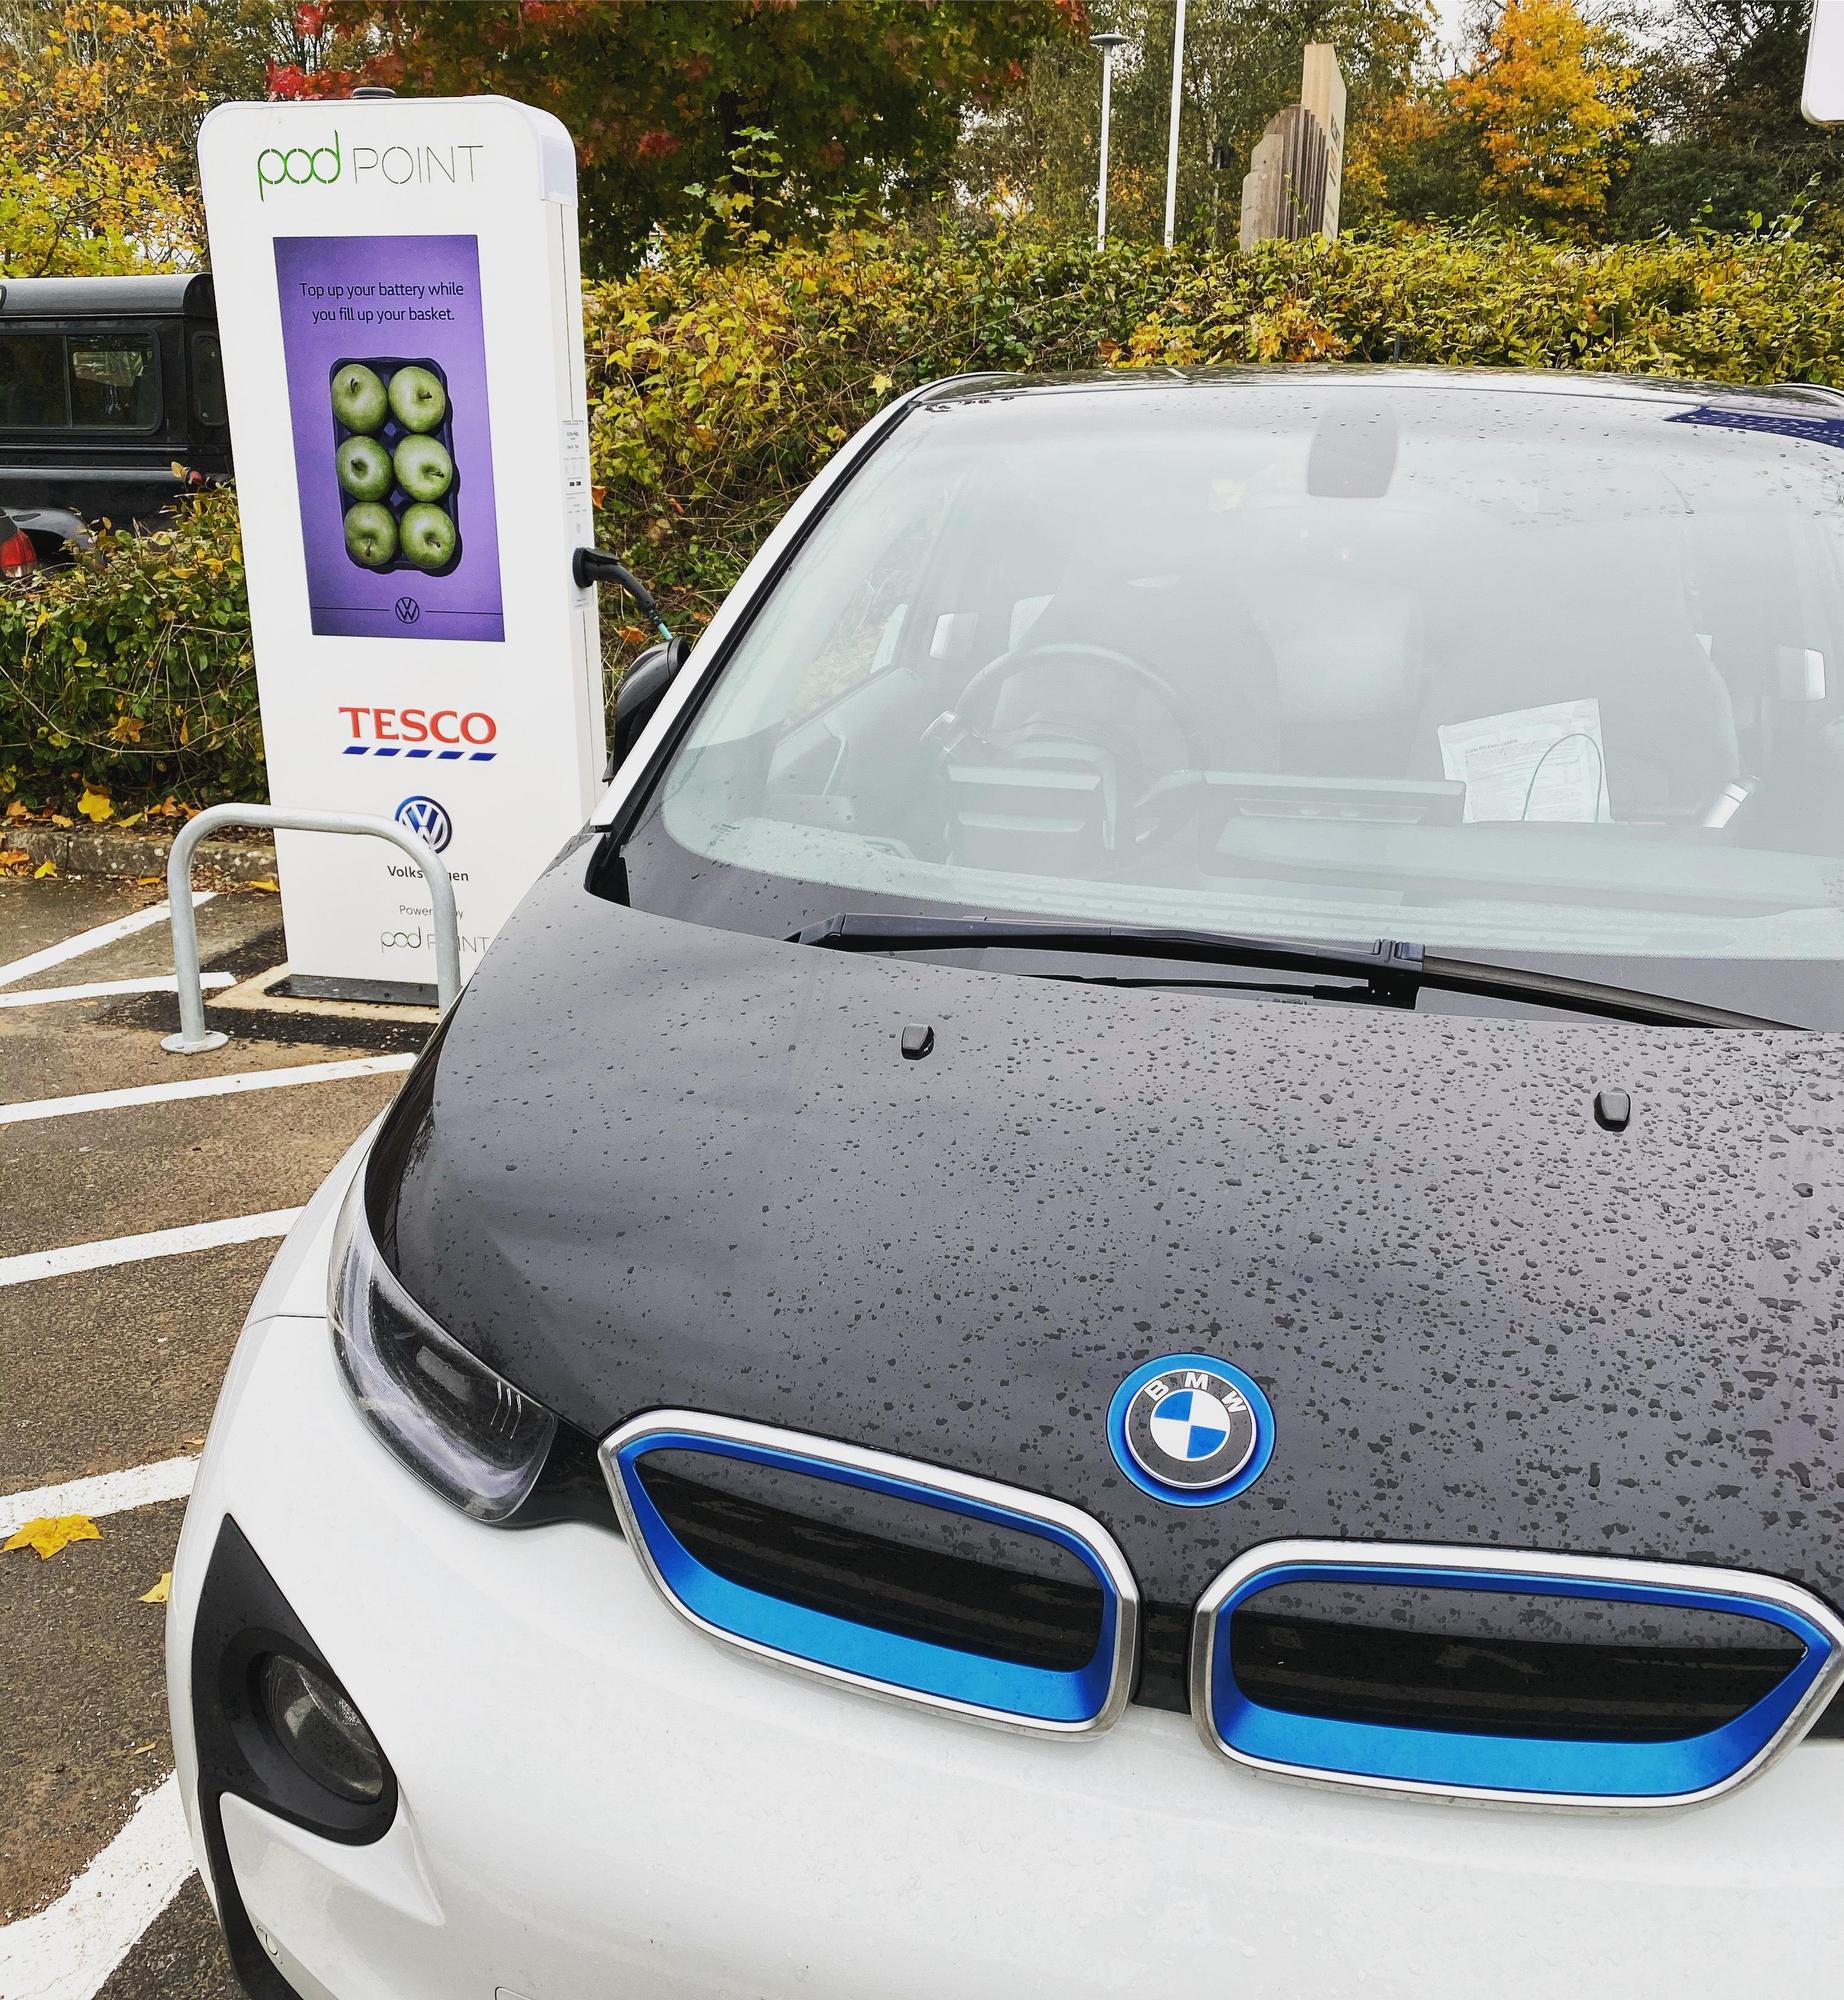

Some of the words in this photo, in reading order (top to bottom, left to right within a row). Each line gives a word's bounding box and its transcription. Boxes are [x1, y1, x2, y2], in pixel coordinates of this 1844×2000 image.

[257, 130, 341, 202] pod
[353, 145, 484, 185] POINT
[300, 283, 324, 299] Top
[328, 285, 344, 299] up
[347, 285, 375, 300] your
[379, 282, 425, 299] battery
[428, 282, 464, 296] while
[312, 309, 336, 324] you
[339, 307, 355, 321] fill
[357, 309, 374, 324] up
[376, 309, 406, 324] your
[409, 307, 455, 321] basket.
[338, 706, 497, 745] TESCO
[387, 865, 469, 882] Volksen
[399, 904, 434, 916] Power
[380, 926, 422, 954] pod
[426, 933, 490, 953] PINT
